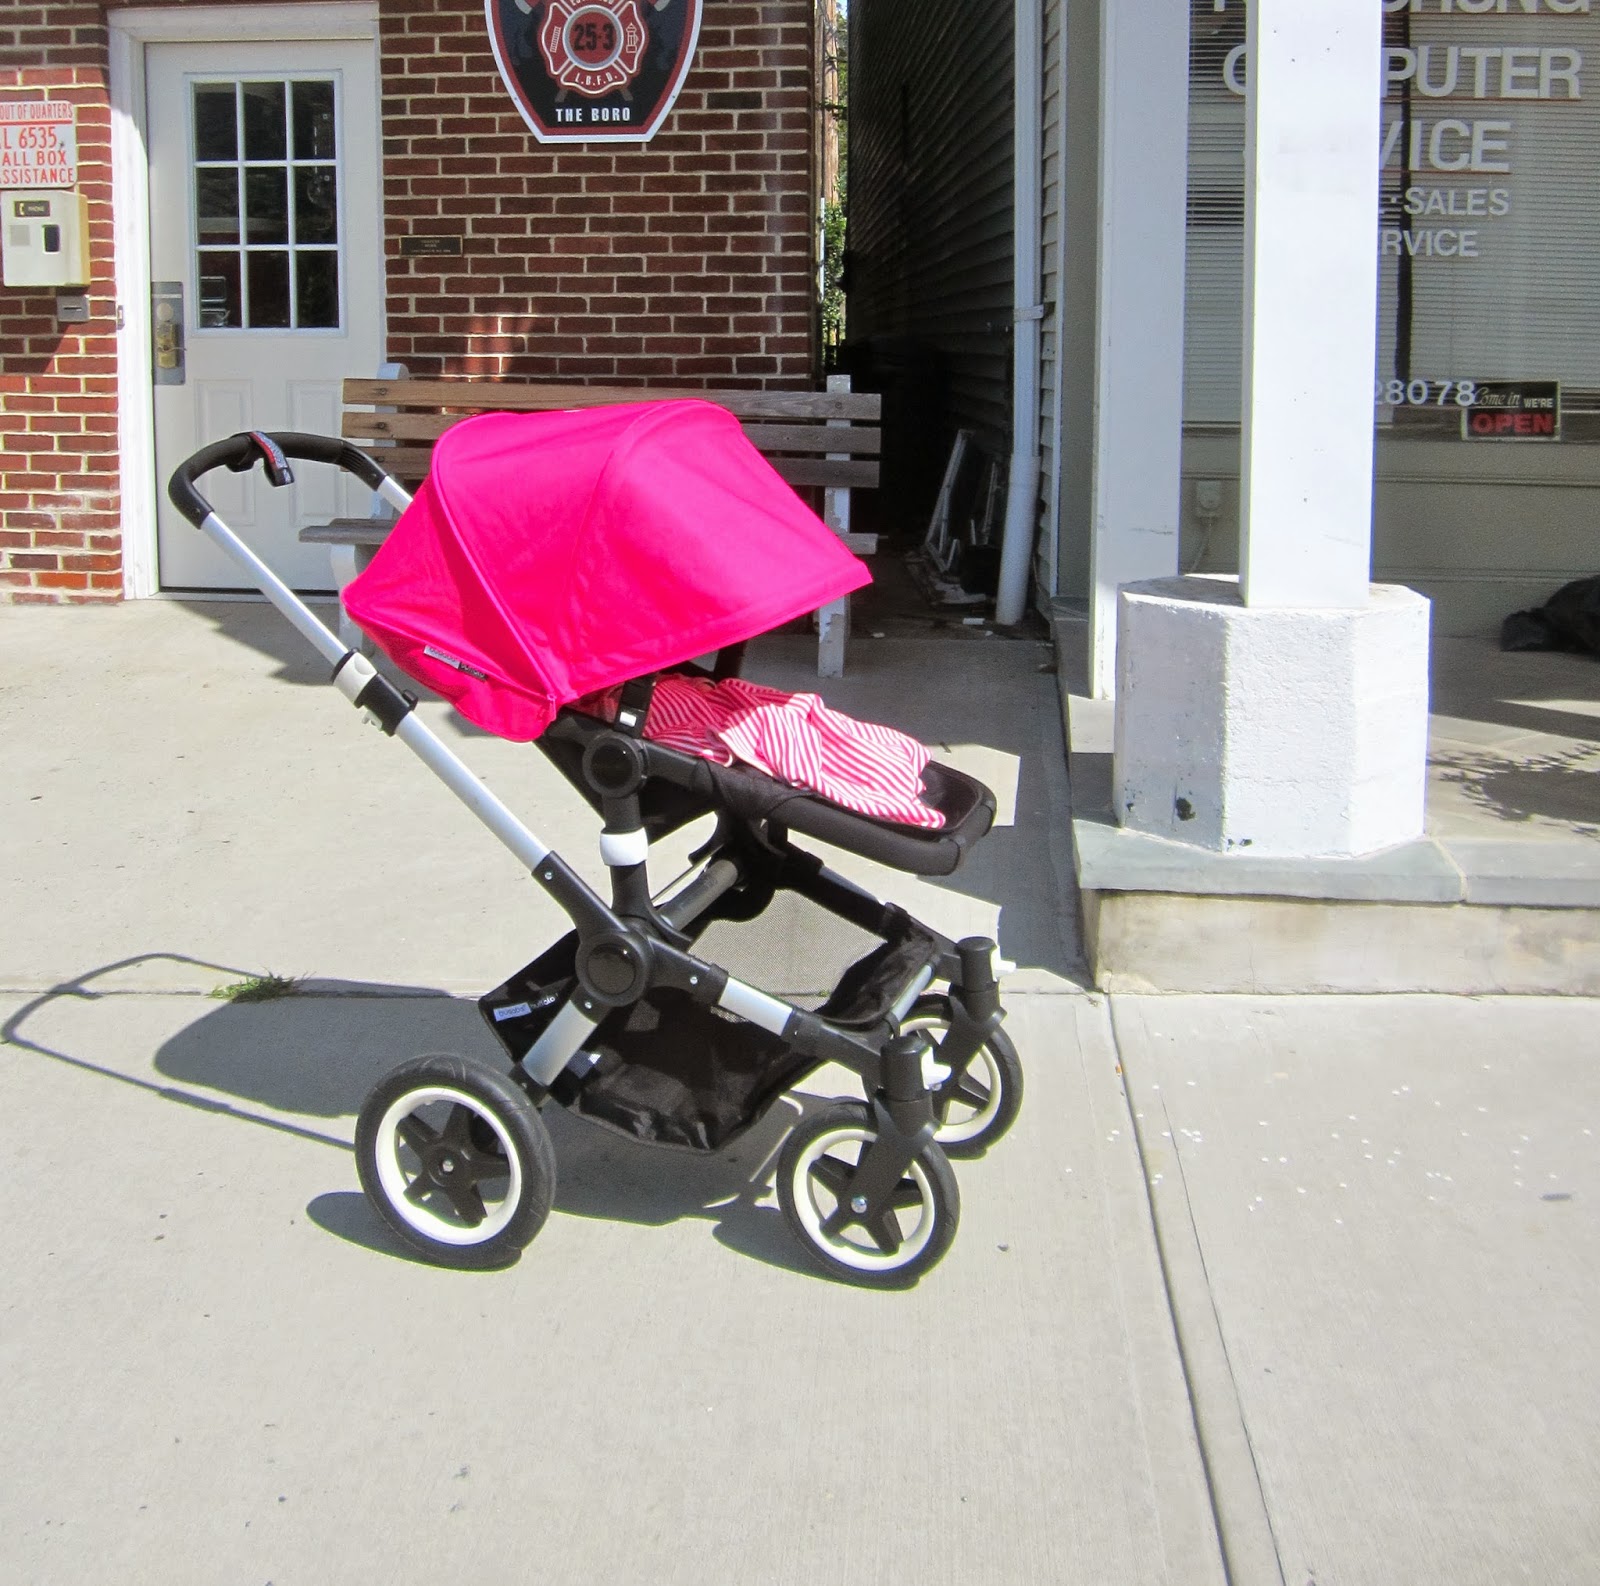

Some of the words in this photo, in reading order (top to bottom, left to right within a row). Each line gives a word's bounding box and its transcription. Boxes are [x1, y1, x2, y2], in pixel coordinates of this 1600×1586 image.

[17, 104, 28, 119] OF
[30, 103, 73, 118] QUARTERS
[556, 108, 582, 122] THE
[591, 107, 631, 122] BORO
[19, 126, 57, 149] 6535
[37, 150, 67, 166] BOX
[0, 167, 74, 184] SSISTANCE
[1473, 386, 1505, 406] Come
[1523, 397, 1554, 408] WE'RE
[1471, 413, 1555, 433] OPEN
